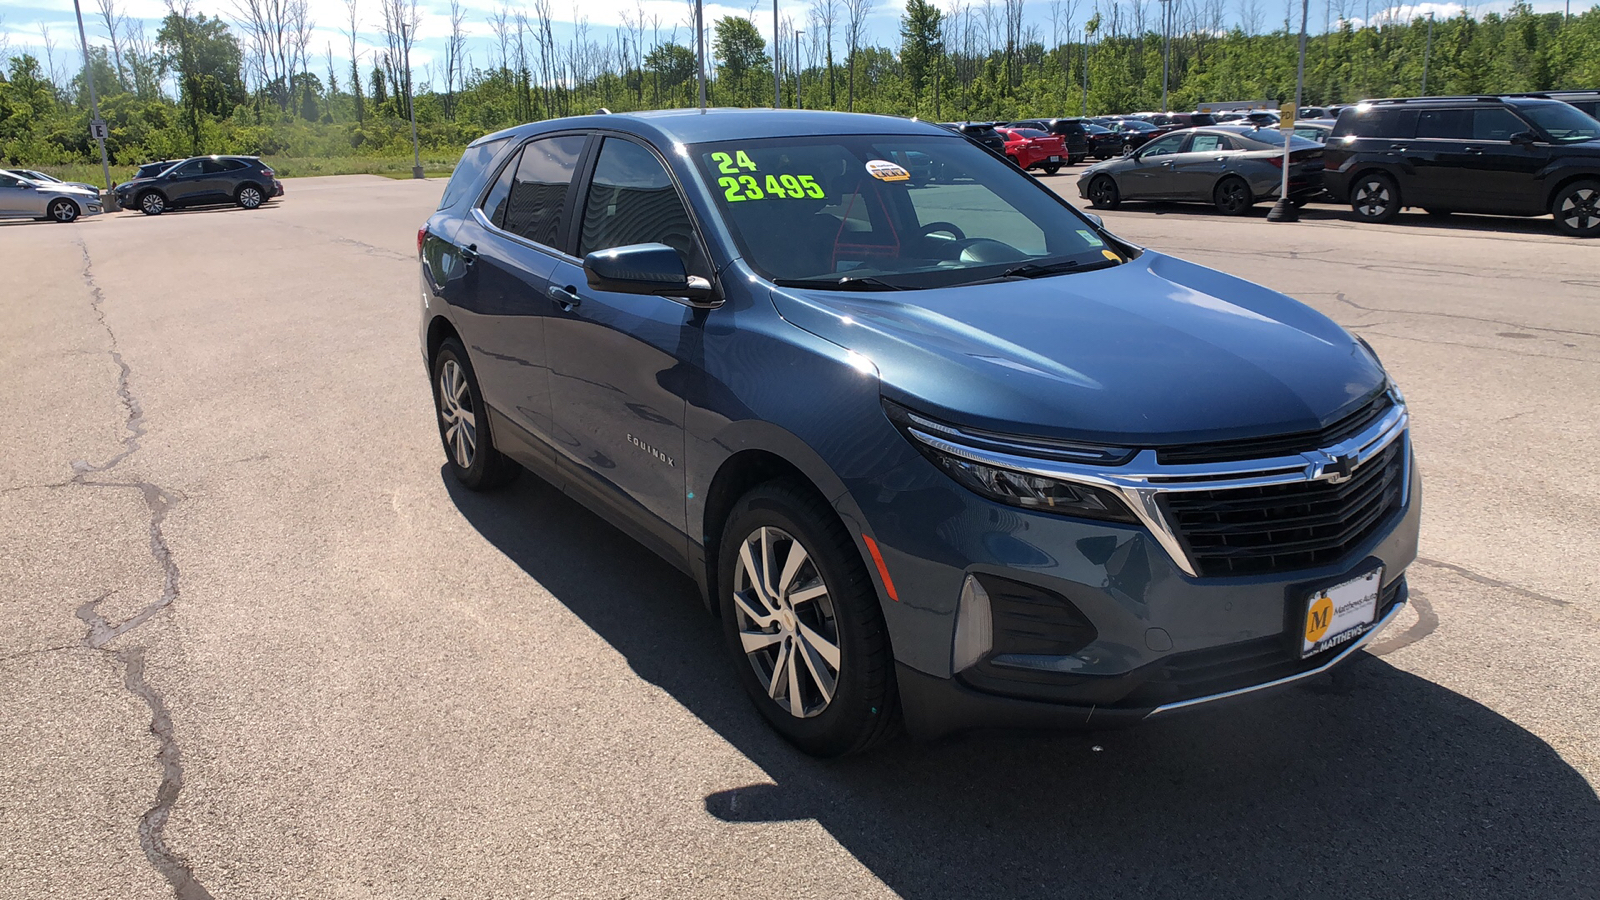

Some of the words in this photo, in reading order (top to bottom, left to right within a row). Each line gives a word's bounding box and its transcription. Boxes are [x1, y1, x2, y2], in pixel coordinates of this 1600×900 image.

[1280, 111, 1294, 120] PDI
[95, 125, 104, 138] E
[711, 150, 757, 174] 24
[718, 174, 825, 202] 23495
[626, 432, 675, 468] EQUINOX
[1308, 605, 1330, 634] M
[1320, 624, 1363, 652] MATTHEWS
